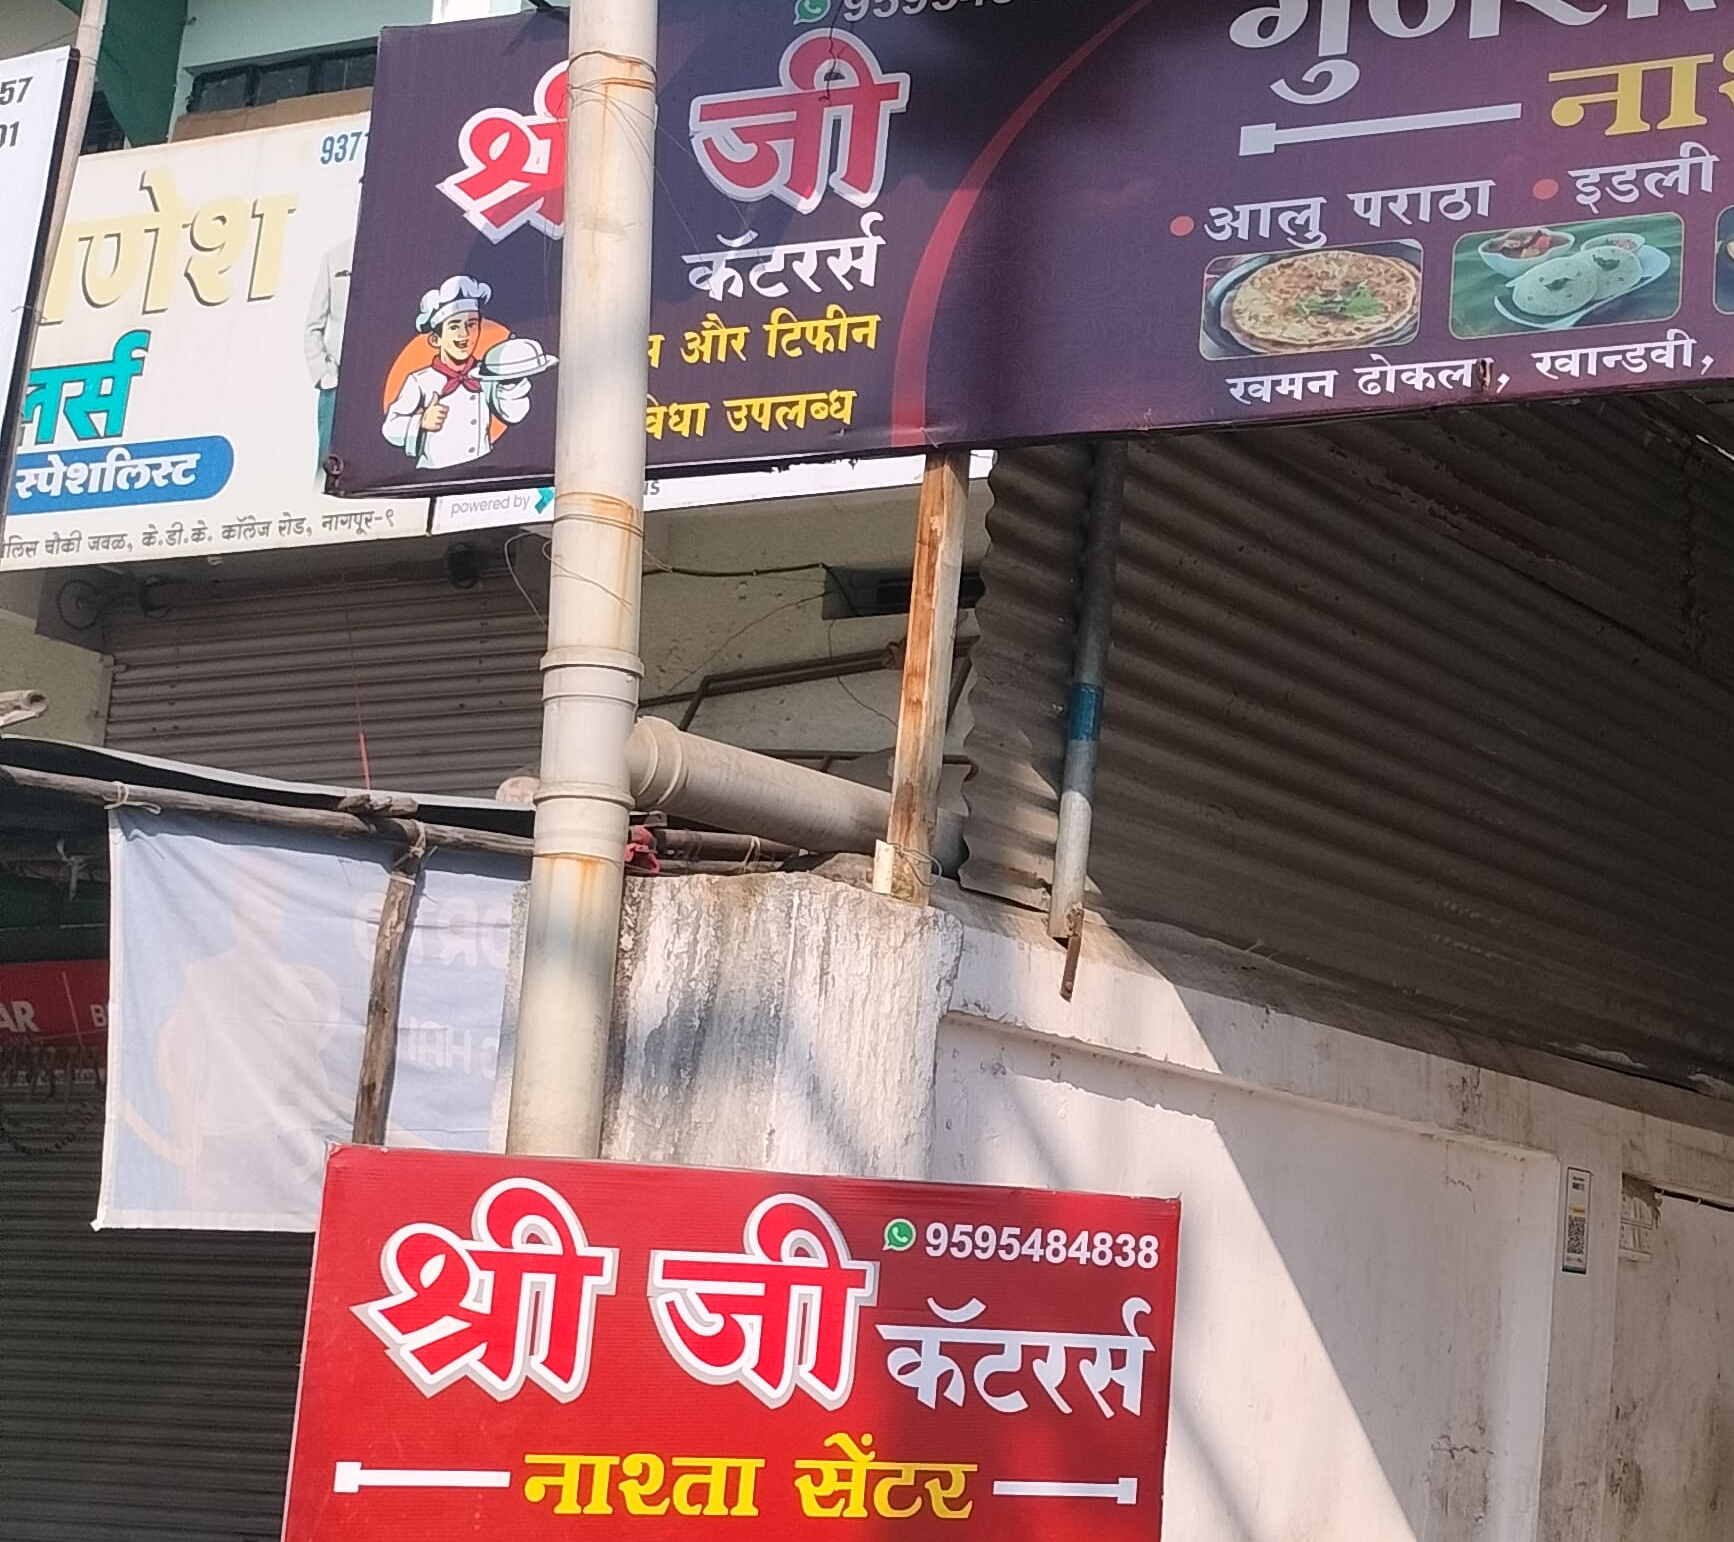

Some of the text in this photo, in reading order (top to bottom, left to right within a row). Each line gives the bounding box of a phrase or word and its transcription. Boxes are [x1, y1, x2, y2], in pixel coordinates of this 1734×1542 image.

[320, 131, 369, 165] 937
[688, 29, 910, 213] जी
[1203, 195, 1328, 248] आलु
[1347, 179, 1497, 228] पराठा
[1570, 140, 1720, 213] इडली
[41, 167, 298, 326] णेश
[682, 211, 886, 301] कॅटरर्स
[680, 313, 750, 364] और
[763, 304, 881, 358] टिफीन
[646, 389, 857, 440] विधा उपलब्ध
[15, 447, 201, 500] स्पेशलिस्ट
[450, 494, 530, 517] powered by
[924, 1222, 1159, 1270] 9595484838
[352, 1178, 878, 1410] श्री जी
[878, 1296, 1156, 1418] कॅटरर्स
[523, 1431, 979, 1521] नाश्ता सेंटर
